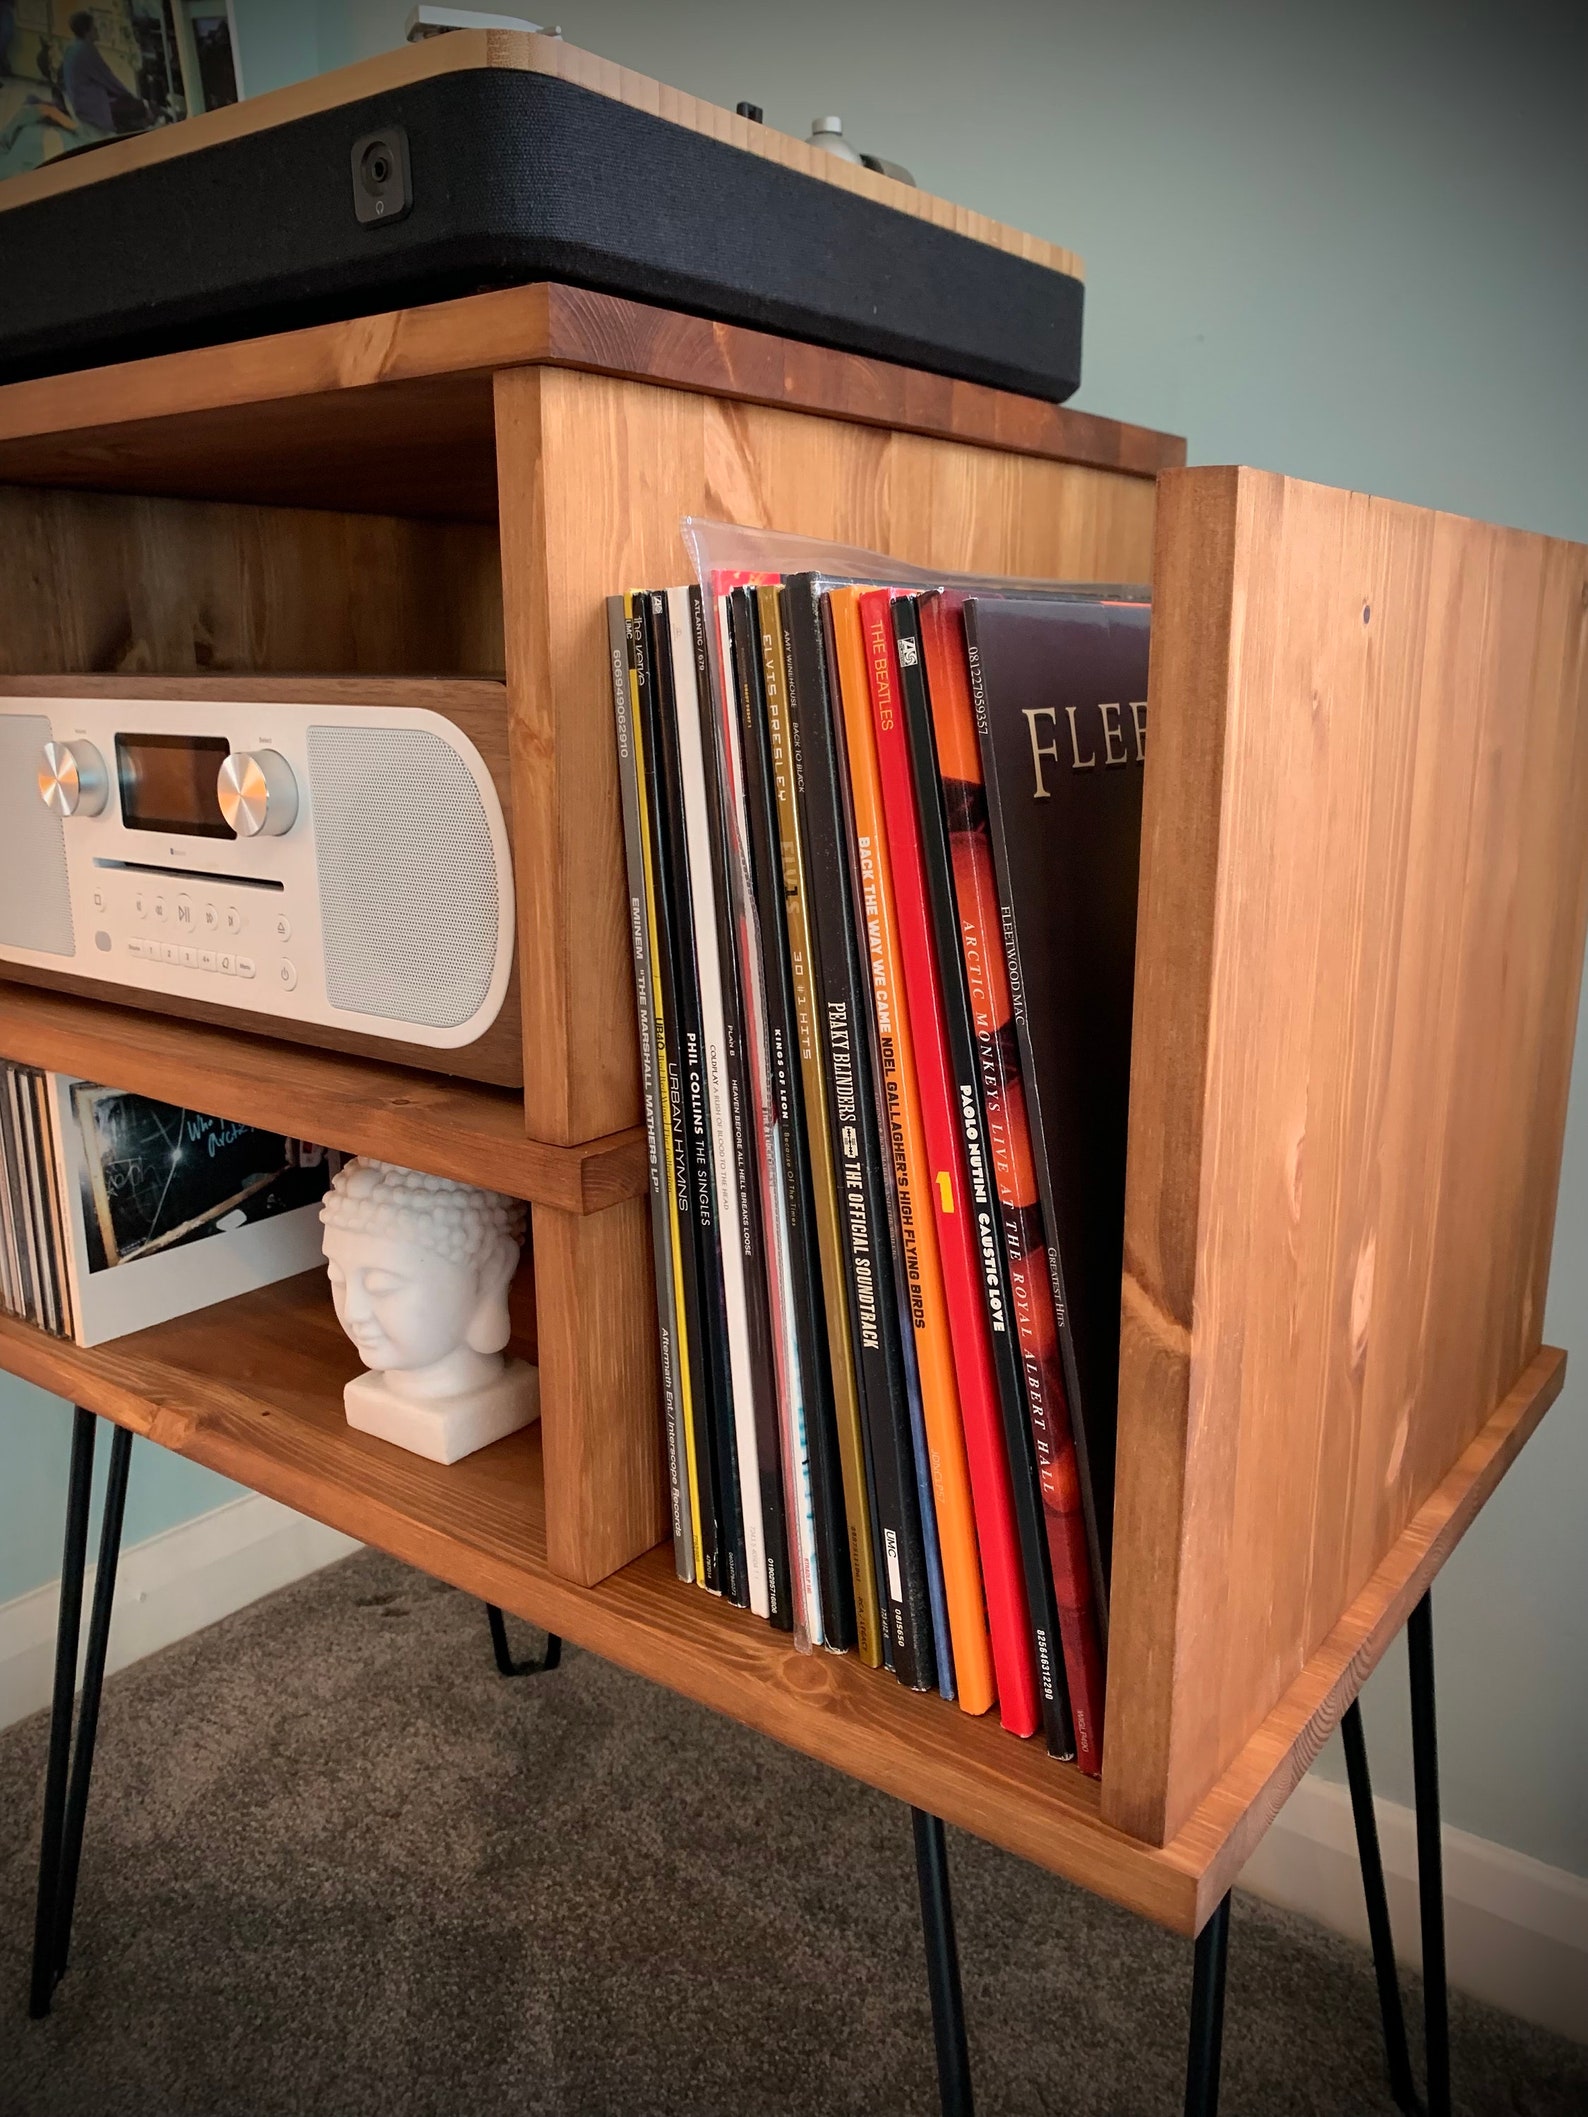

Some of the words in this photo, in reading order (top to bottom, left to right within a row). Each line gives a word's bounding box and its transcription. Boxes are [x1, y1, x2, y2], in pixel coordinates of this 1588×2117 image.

[625, 619, 633, 640] UMC
[633, 616, 643, 641] the
[694, 599, 704, 646] ATLANTIC
[784, 630, 792, 653] AMY
[869, 619, 887, 655] THE
[762, 634, 777, 696] ELVIS
[786, 654, 797, 708] WINEHOUSE
[613, 649, 629, 759] 606949062910
[873, 657, 894, 731] BEATLES
[968, 646, 989, 736] 081227959357
[769, 704, 787, 801] PRESLEY
[792, 722, 800, 746] BACK
[796, 748, 802, 761] TO
[797, 762, 805, 792] BLACK
[857, 836, 876, 881] BACK
[864, 883, 879, 916] THE
[631, 897, 644, 960] EMINEM
[868, 918, 883, 956] WAY
[871, 958, 886, 988] WE
[962, 920, 985, 1001] ARCTIC
[1000, 905, 1021, 991] FLEETWOOD
[1013, 993, 1026, 1026] MAC
[793, 951, 804, 976] 30
[800, 1014, 812, 1060] HITS
[828, 1001, 849, 1051] PEAKY
[875, 990, 891, 1034] CAME
[640, 1009, 653, 1089] MARSHALL
[654, 1017, 664, 1050] UB40
[686, 1033, 697, 1067] PHIL
[727, 1024, 735, 1047] PLAN
[775, 1028, 784, 1066] KINGS
[709, 1044, 720, 1085] COLDPLAY
[778, 1070, 786, 1085] OF
[881, 1037, 896, 1078] NOEL
[975, 1011, 1001, 1112] MONKEYS
[668, 1062, 683, 1133] URBAN
[689, 1072, 704, 1135] COLLINS
[714, 1094, 722, 1115] RUSH
[731, 1079, 740, 1113] HEAVEN
[780, 1089, 789, 1119] LEON
[832, 1052, 856, 1122] BLINDERS
[645, 1095, 657, 1165] MATHERS
[716, 1116, 723, 1128] OF
[733, 1115, 743, 1148] BEFORE
[960, 1085, 978, 1141] PAOLO
[695, 1139, 706, 1164] THE
[717, 1129, 725, 1156] BLOOD
[784, 1131, 792, 1168] Because
[886, 1081, 909, 1187] GALLAGHER'S
[991, 1123, 1010, 1174] LIVE
[674, 1139, 689, 1211] HYMNS
[719, 1158, 726, 1169] TO
[735, 1150, 744, 1166] ALL
[787, 1170, 794, 1182] Of
[844, 1162, 863, 1189] THE
[967, 1143, 988, 1204] NUTINI
[697, 1170, 711, 1226] SINGLES
[721, 1188, 729, 1210] HEAD
[737, 1168, 746, 1190] HELL
[788, 1184, 796, 1199] The
[935, 1171, 955, 1213] 1
[1000, 1185, 1014, 1209] AT
[739, 1191, 749, 1225] BREAKS
[848, 1192, 870, 1254] OFFICIAL
[899, 1191, 913, 1227] HIGH
[742, 1227, 752, 1256] LOOSE
[903, 1229, 920, 1281] FLYING
[977, 1213, 999, 1287] CAUSTIC
[1005, 1221, 1022, 1261] THE
[854, 1258, 880, 1350] SOUNDTRACK
[909, 1283, 926, 1329] BIRDS
[1012, 1272, 1033, 1338] ROYAL
[1048, 1247, 1064, 1301] GREATEST
[1056, 1302, 1066, 1328] HITS
[987, 1288, 1006, 1332] LOVE
[1024, 1347, 1046, 1431] ALBERT
[661, 1327, 673, 1388] Aftermath
[667, 1420, 679, 1485] Interscope
[673, 1487, 683, 1537] Records
[1037, 1439, 1055, 1493] HALL
[884, 1529, 897, 1559] UMC
[894, 1608, 905, 1648] 0815650
[1036, 1629, 1054, 1701] 825646312290
